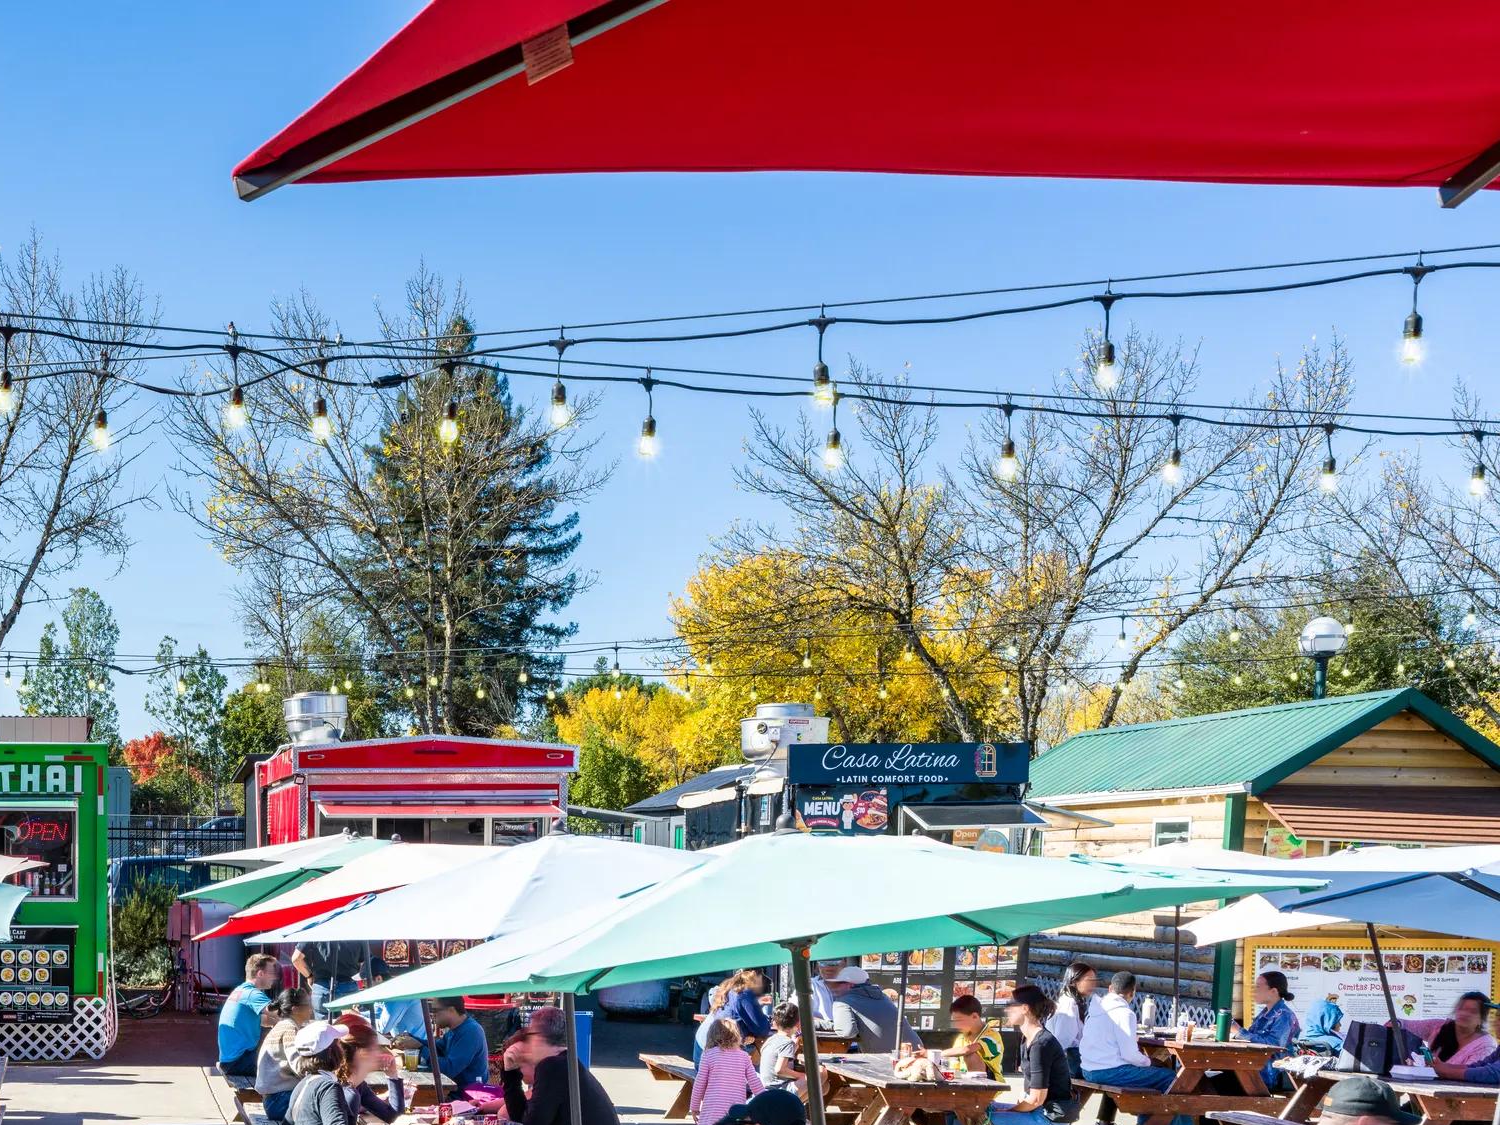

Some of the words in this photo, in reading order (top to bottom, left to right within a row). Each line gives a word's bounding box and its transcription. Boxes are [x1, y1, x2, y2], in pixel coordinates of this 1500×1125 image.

[822, 745, 881, 770] Casa
[884, 743, 960, 771] Latina
[841, 775, 868, 783] LATIN
[871, 775, 916, 783] COMFORT
[918, 775, 944, 783] FOOD
[804, 801, 841, 816] MENU
[17, 821, 68, 841] OPEN
[954, 830, 978, 838] Open
